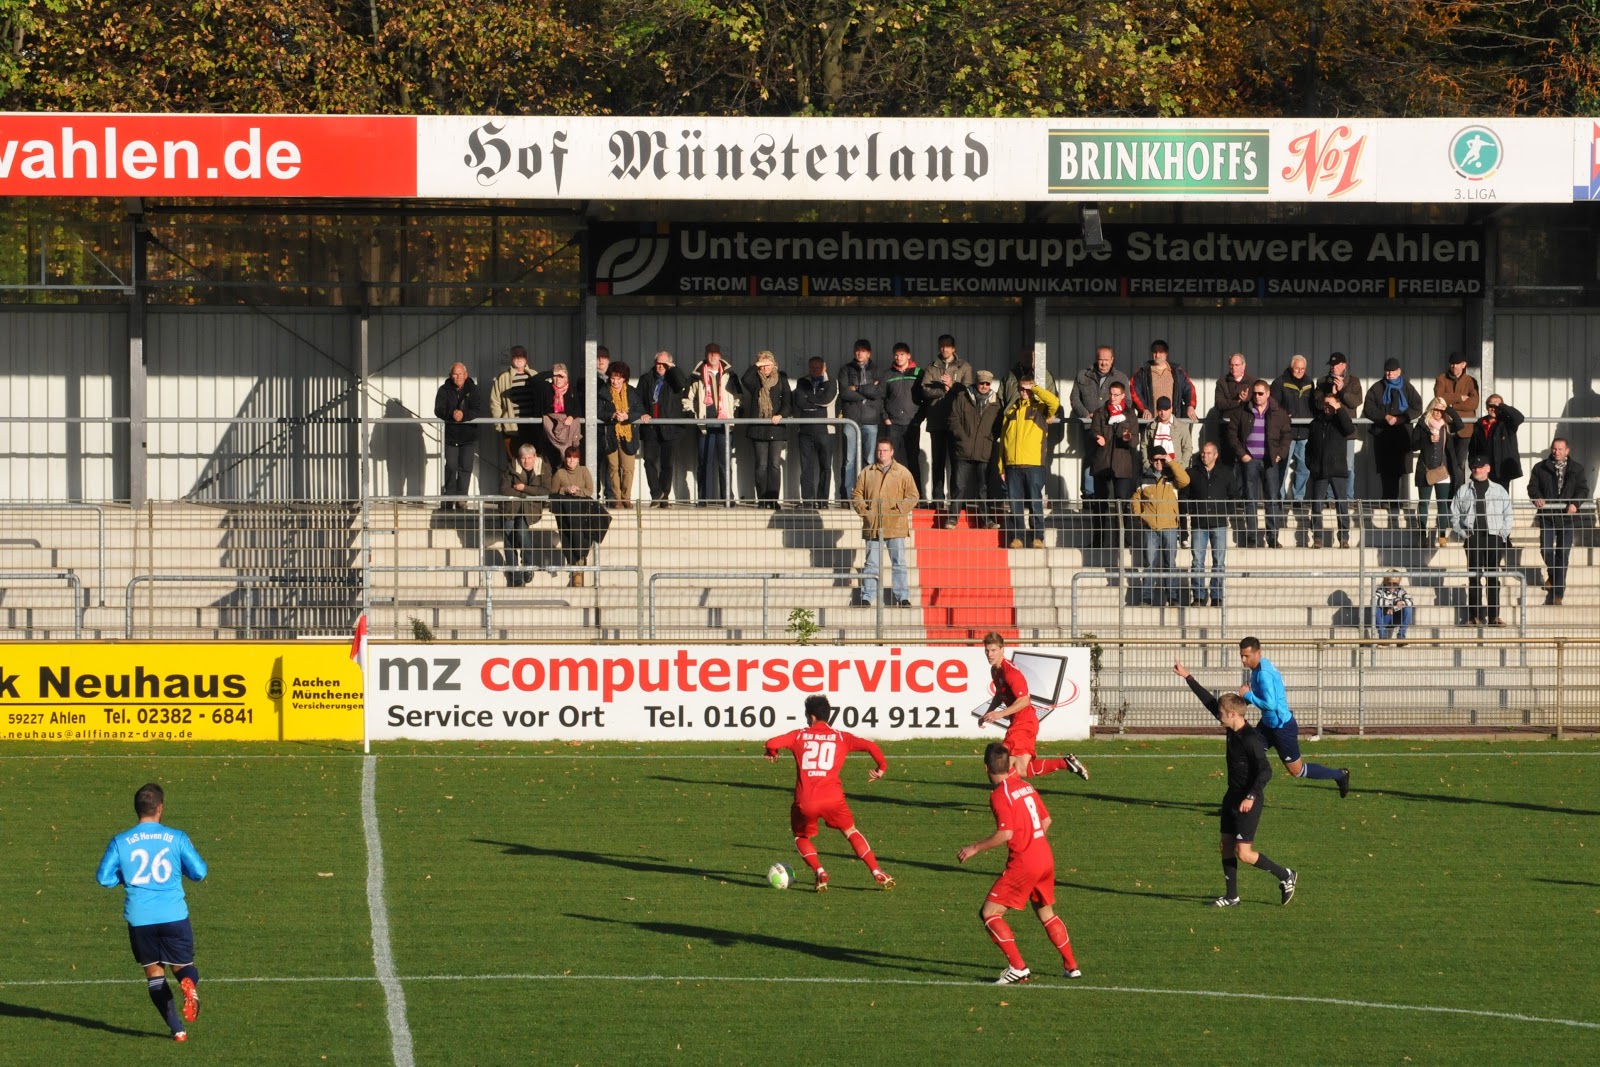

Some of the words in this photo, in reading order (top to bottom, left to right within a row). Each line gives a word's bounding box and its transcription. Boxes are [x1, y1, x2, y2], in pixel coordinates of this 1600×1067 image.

[464, 121, 568, 196] Hof
[608, 130, 989, 182] Münsterland
[680, 229, 1112, 267] Unternehmensgruppe
[1127, 231, 1353, 262] Stadtwerke
[1367, 232, 1480, 262] Ahlen
[680, 277, 747, 291] STROM
[760, 277, 799, 291] GAS
[812, 277, 892, 291] WASSER
[905, 278, 1118, 292] TELEKOMMUNIKATION
[1130, 279, 1255, 293] FREIZEITBAD
[1268, 279, 1385, 293] SAUNADORF
[1398, 279, 1480, 293] FREIBAD
[39, 665, 247, 699] Neuhaus
[292, 677, 340, 687] Aachen
[379, 657, 462, 691] mz
[480, 647, 968, 703] computerservice
[292, 689, 364, 700] Münchener
[292, 702, 364, 711] Versicherungen
[8, 713, 44, 724] 59227
[50, 711, 86, 724] Ahlen
[104, 708, 131, 724] Tel.
[137, 708, 192, 724] 02382
[212, 708, 253, 724] 6841
[388, 704, 493, 728] Service
[502, 710, 549, 728] vor
[558, 704, 605, 728] Ort
[644, 705, 693, 728] Tel.
[704, 706, 776, 728] 0160
[888, 706, 959, 728] 9121
[0, 729, 193, 740] .neuhaus@allfinanz-dvag.de
[802, 741, 836, 770] 20
[130, 847, 172, 885] 26
